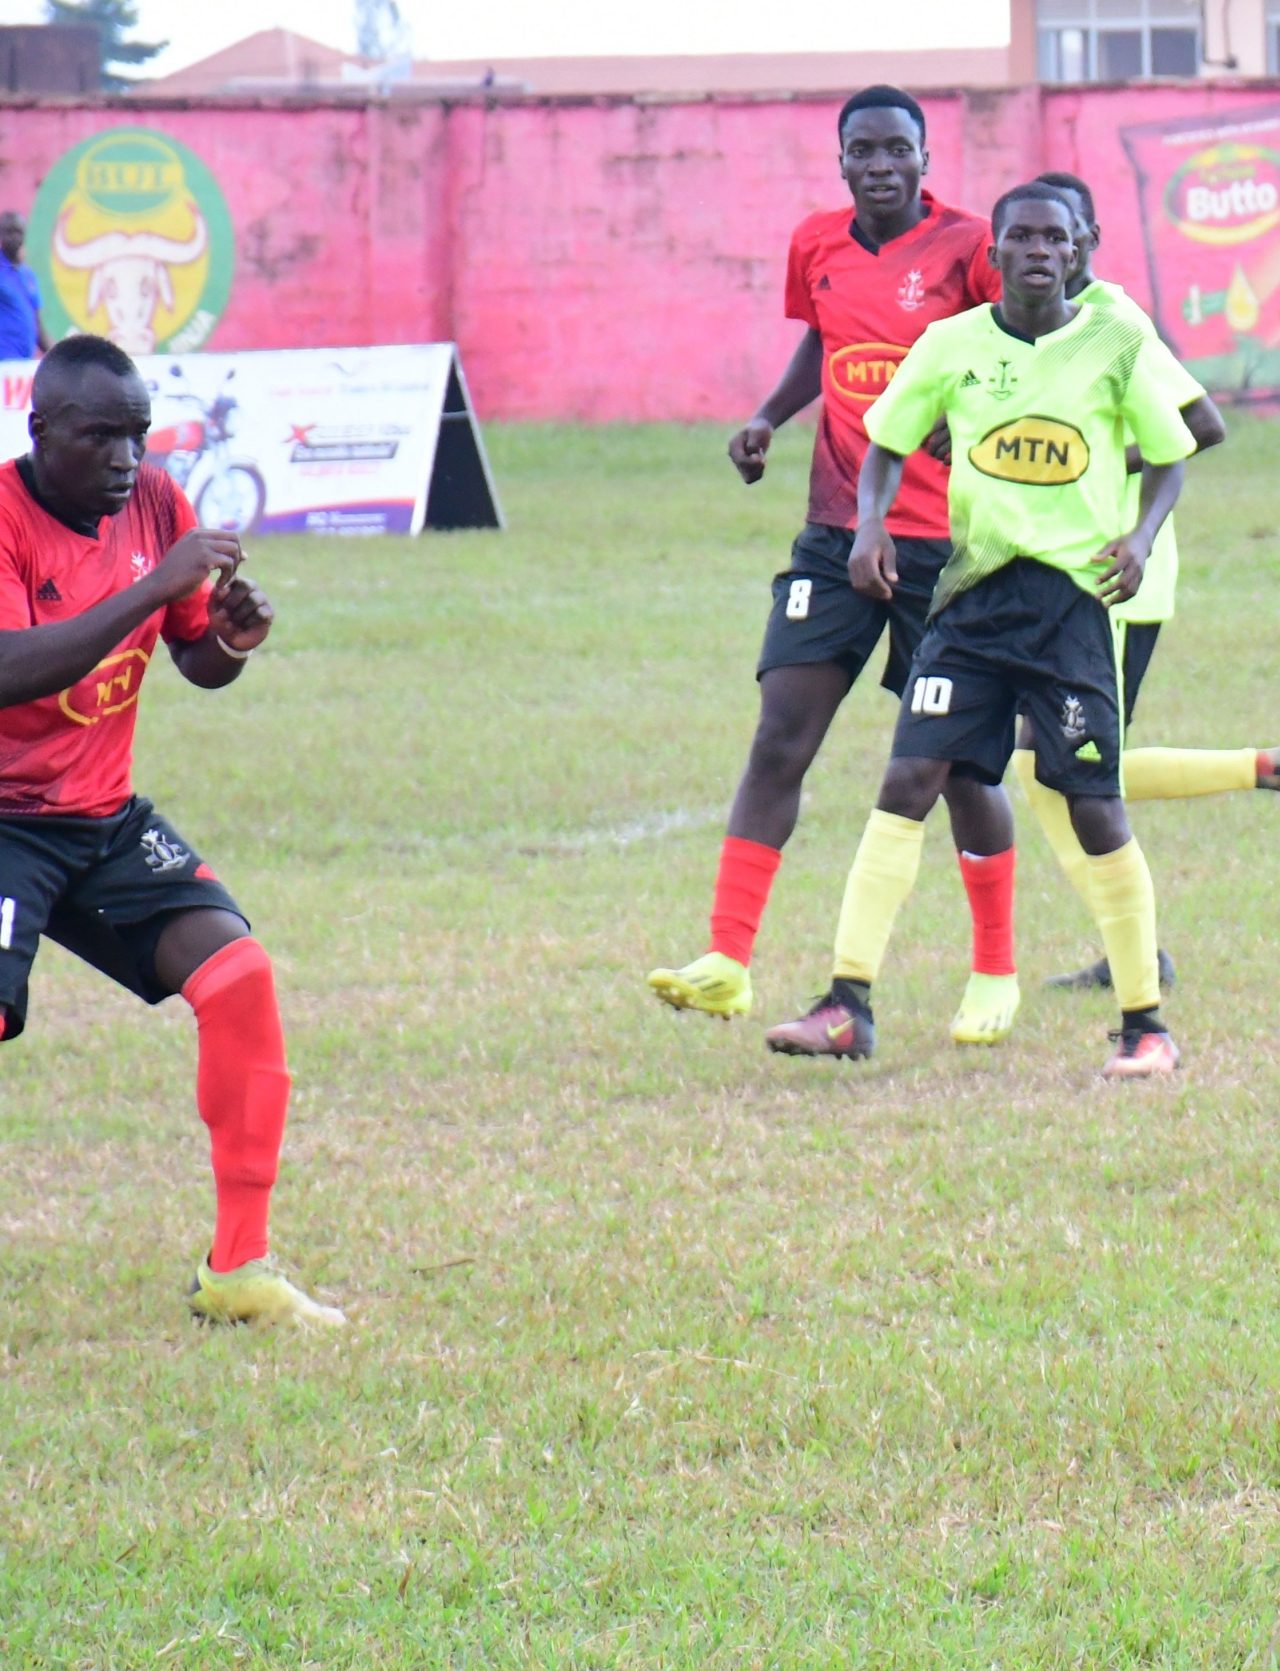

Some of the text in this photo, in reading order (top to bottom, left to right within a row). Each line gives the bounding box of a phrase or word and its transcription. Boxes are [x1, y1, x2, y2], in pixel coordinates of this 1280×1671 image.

[1187, 179, 1277, 220] Butto
[995, 435, 1069, 466] MTN
[786, 579, 812, 620] 8
[911, 676, 953, 715] 10
[0, 895, 16, 950] 1
